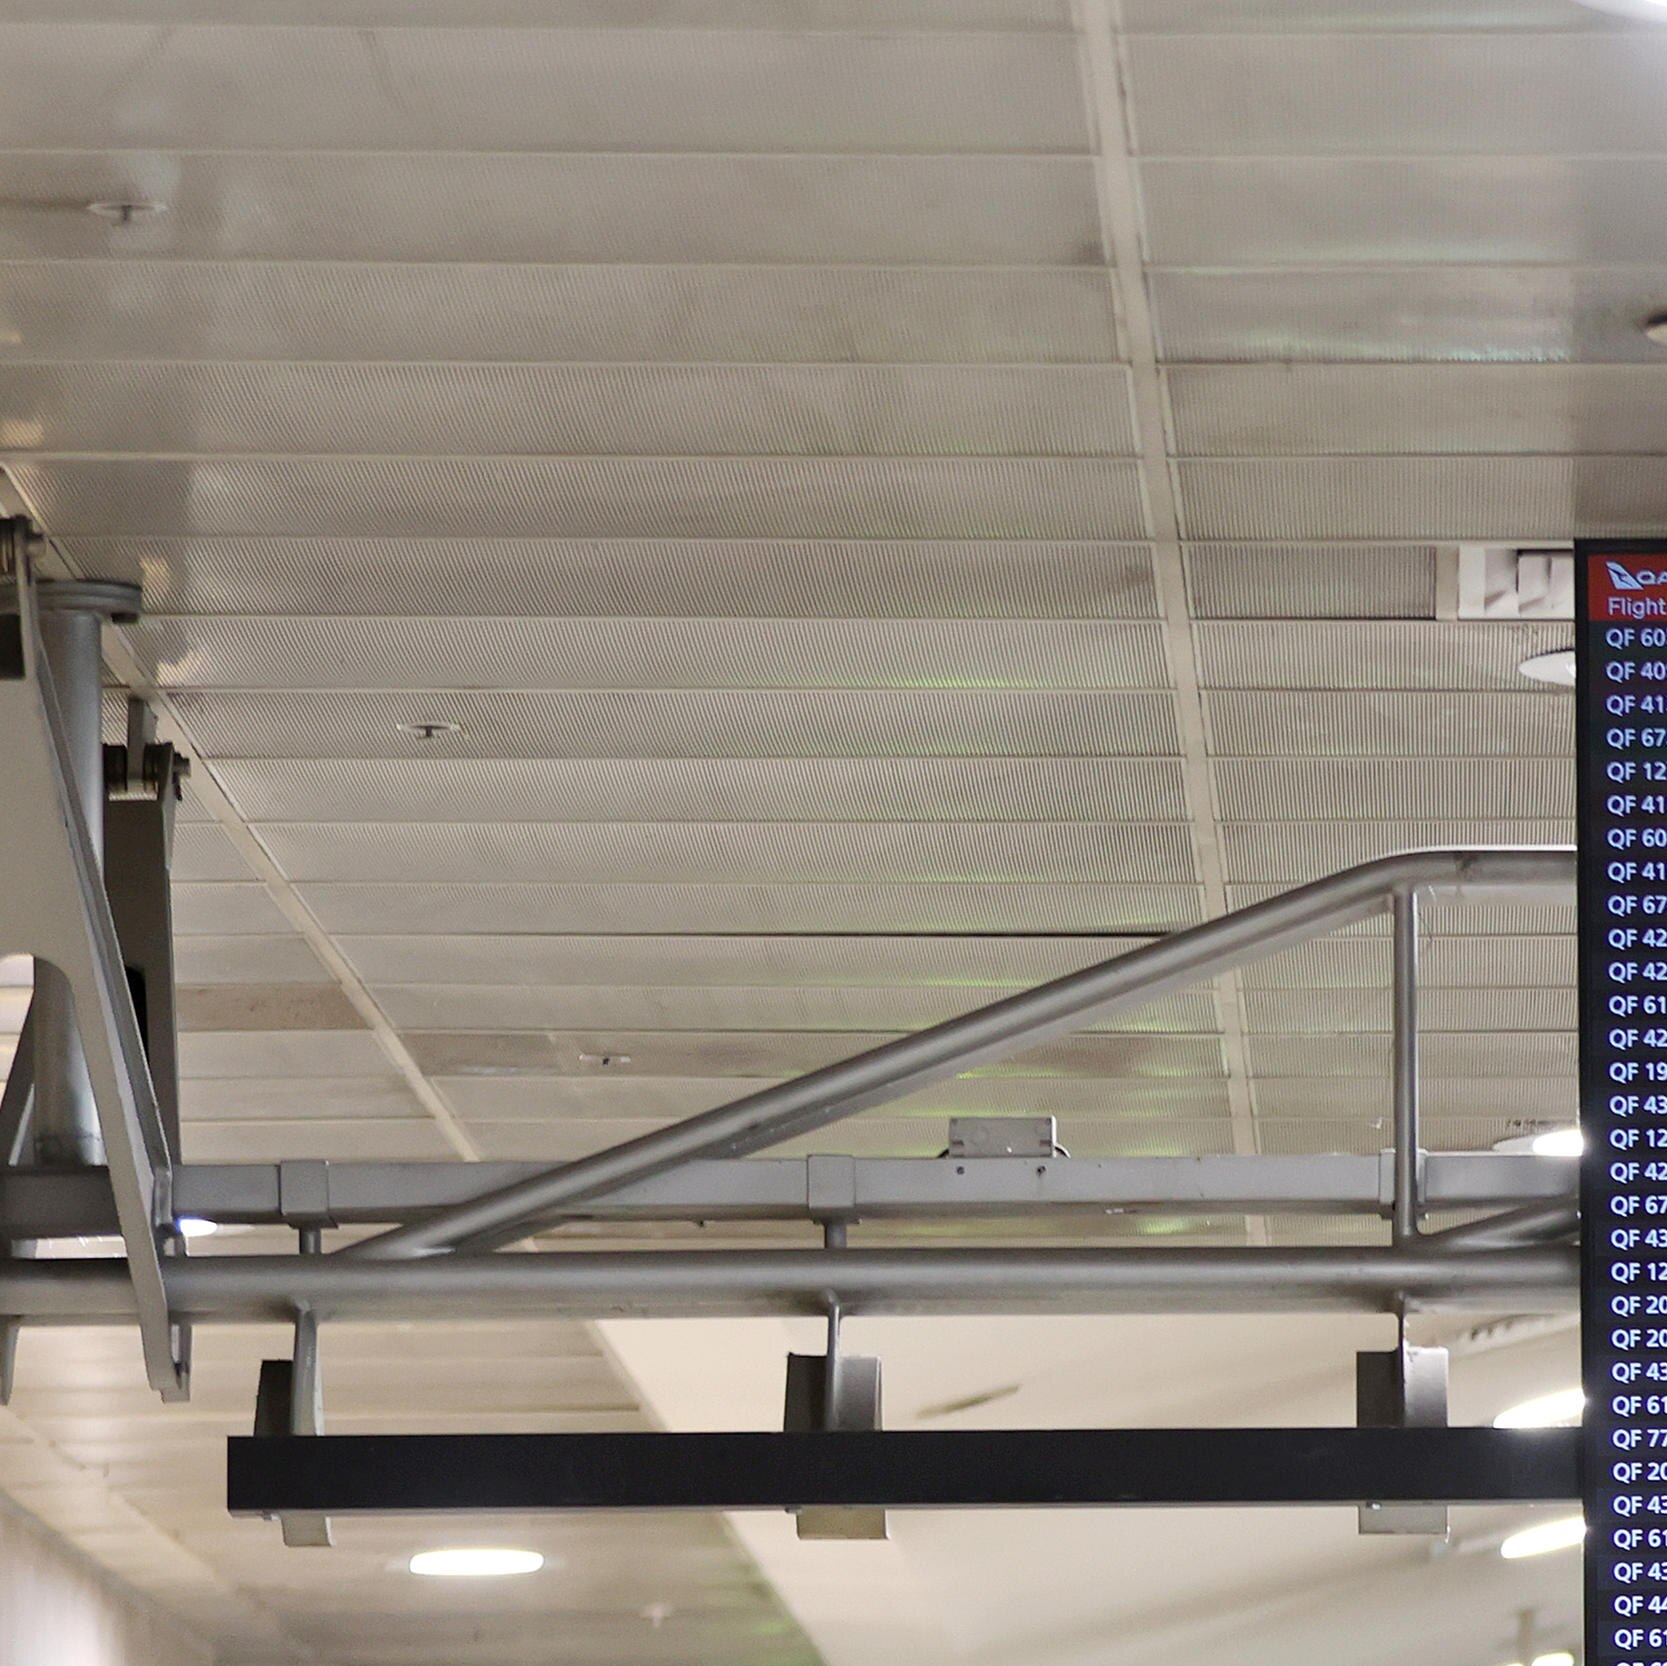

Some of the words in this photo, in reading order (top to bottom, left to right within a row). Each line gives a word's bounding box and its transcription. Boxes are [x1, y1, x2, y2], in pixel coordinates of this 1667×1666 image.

[1608, 597, 1667, 620] Flight
[1606, 628, 1635, 650] QF
[1609, 1028, 1639, 1051] QF
[1609, 1062, 1639, 1084] QF
[1611, 1295, 1641, 1318] QF
